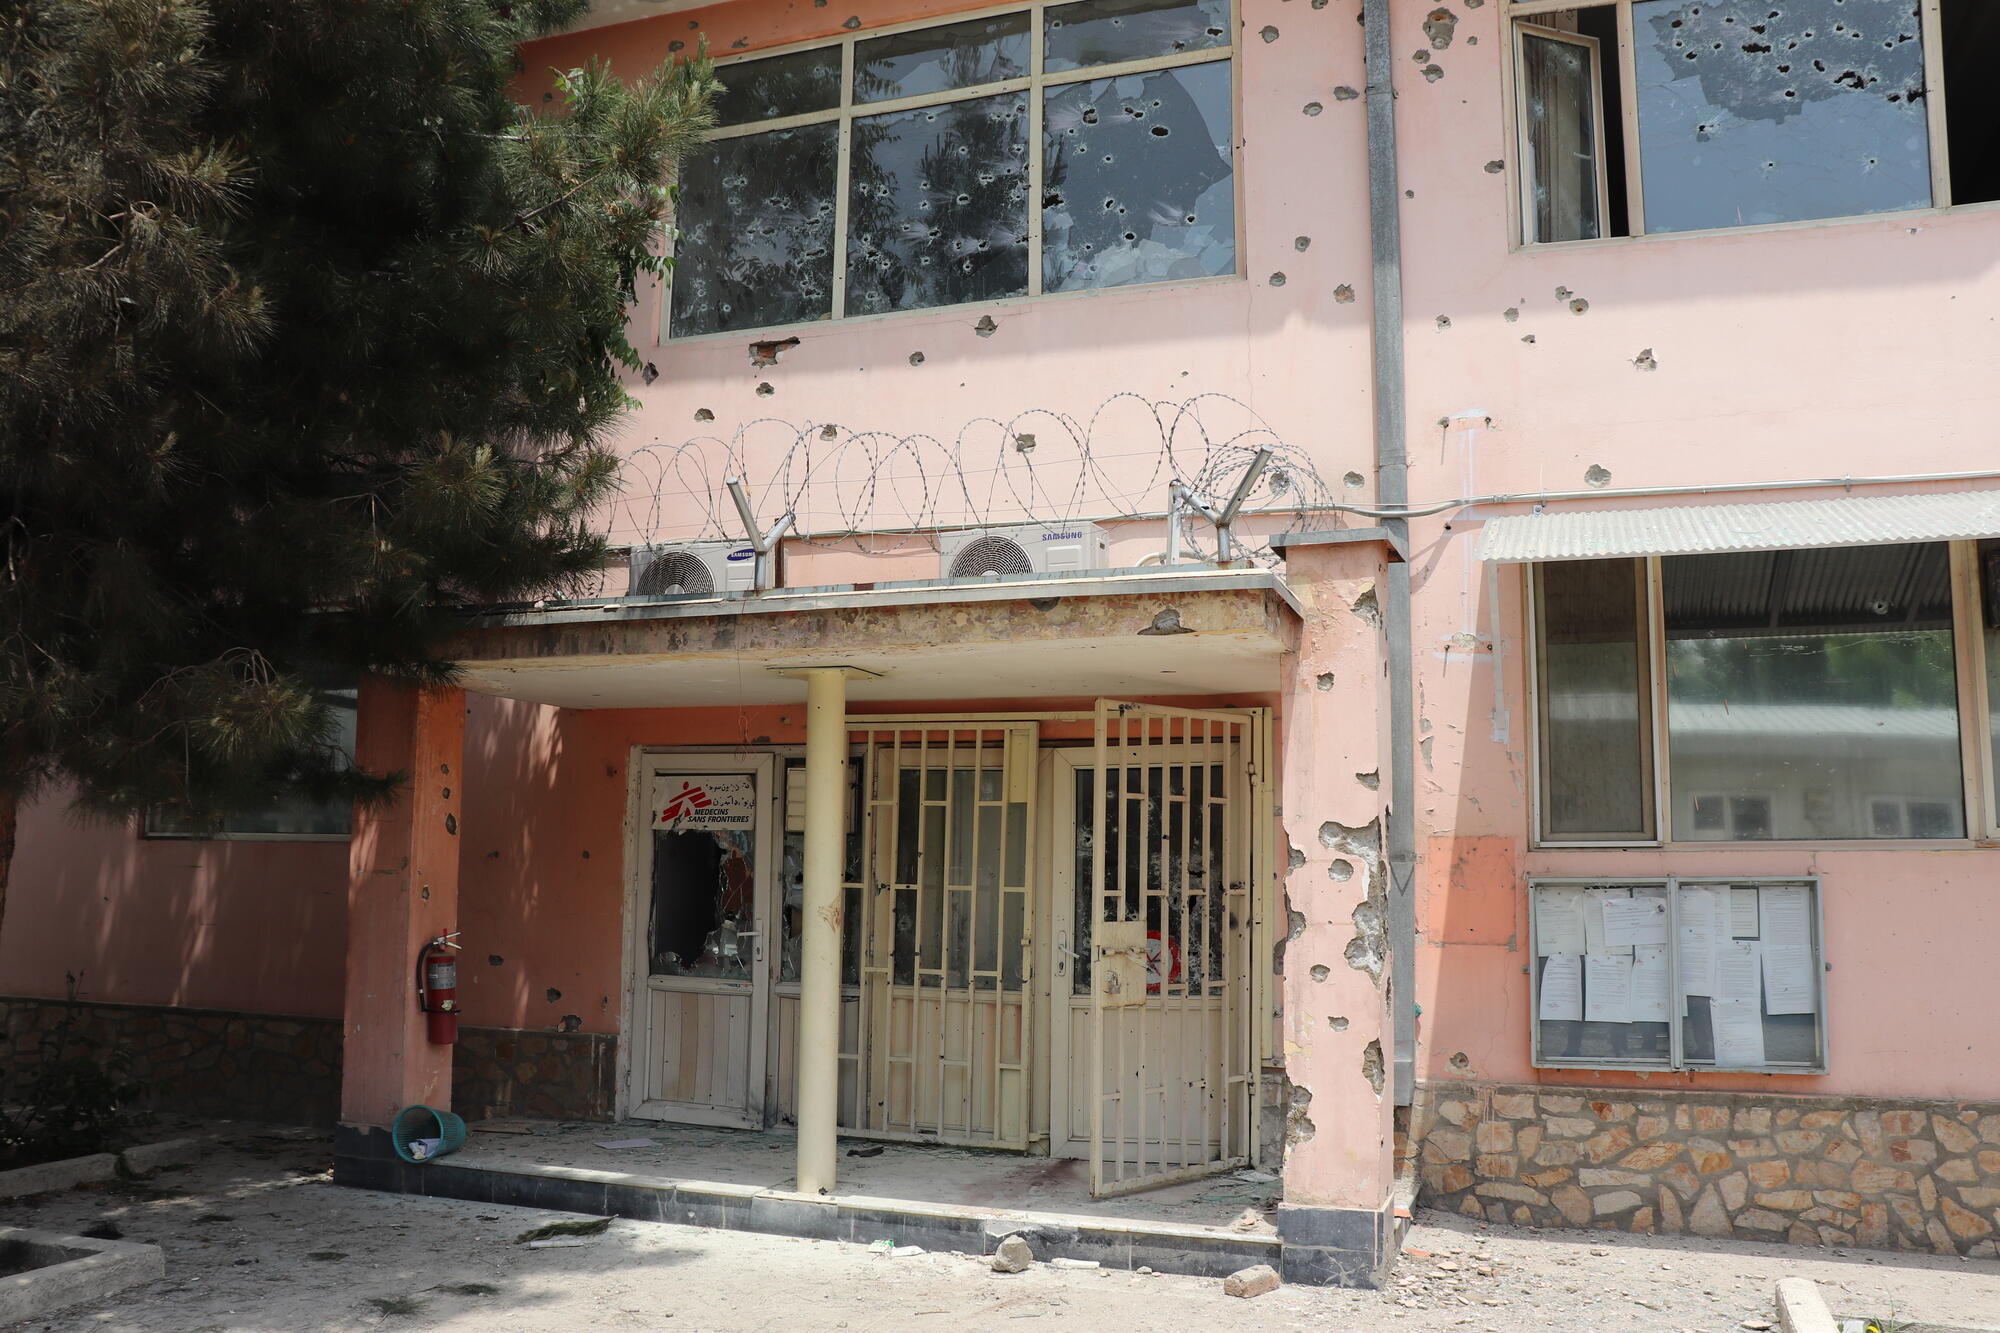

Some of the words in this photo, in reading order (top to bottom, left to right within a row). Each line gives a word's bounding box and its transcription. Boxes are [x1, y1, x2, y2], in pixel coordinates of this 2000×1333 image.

[1042, 531, 1083, 542] SAMSUNG
[694, 808, 729, 816] MEDECINS
[707, 815, 750, 823] FRONTIERES
